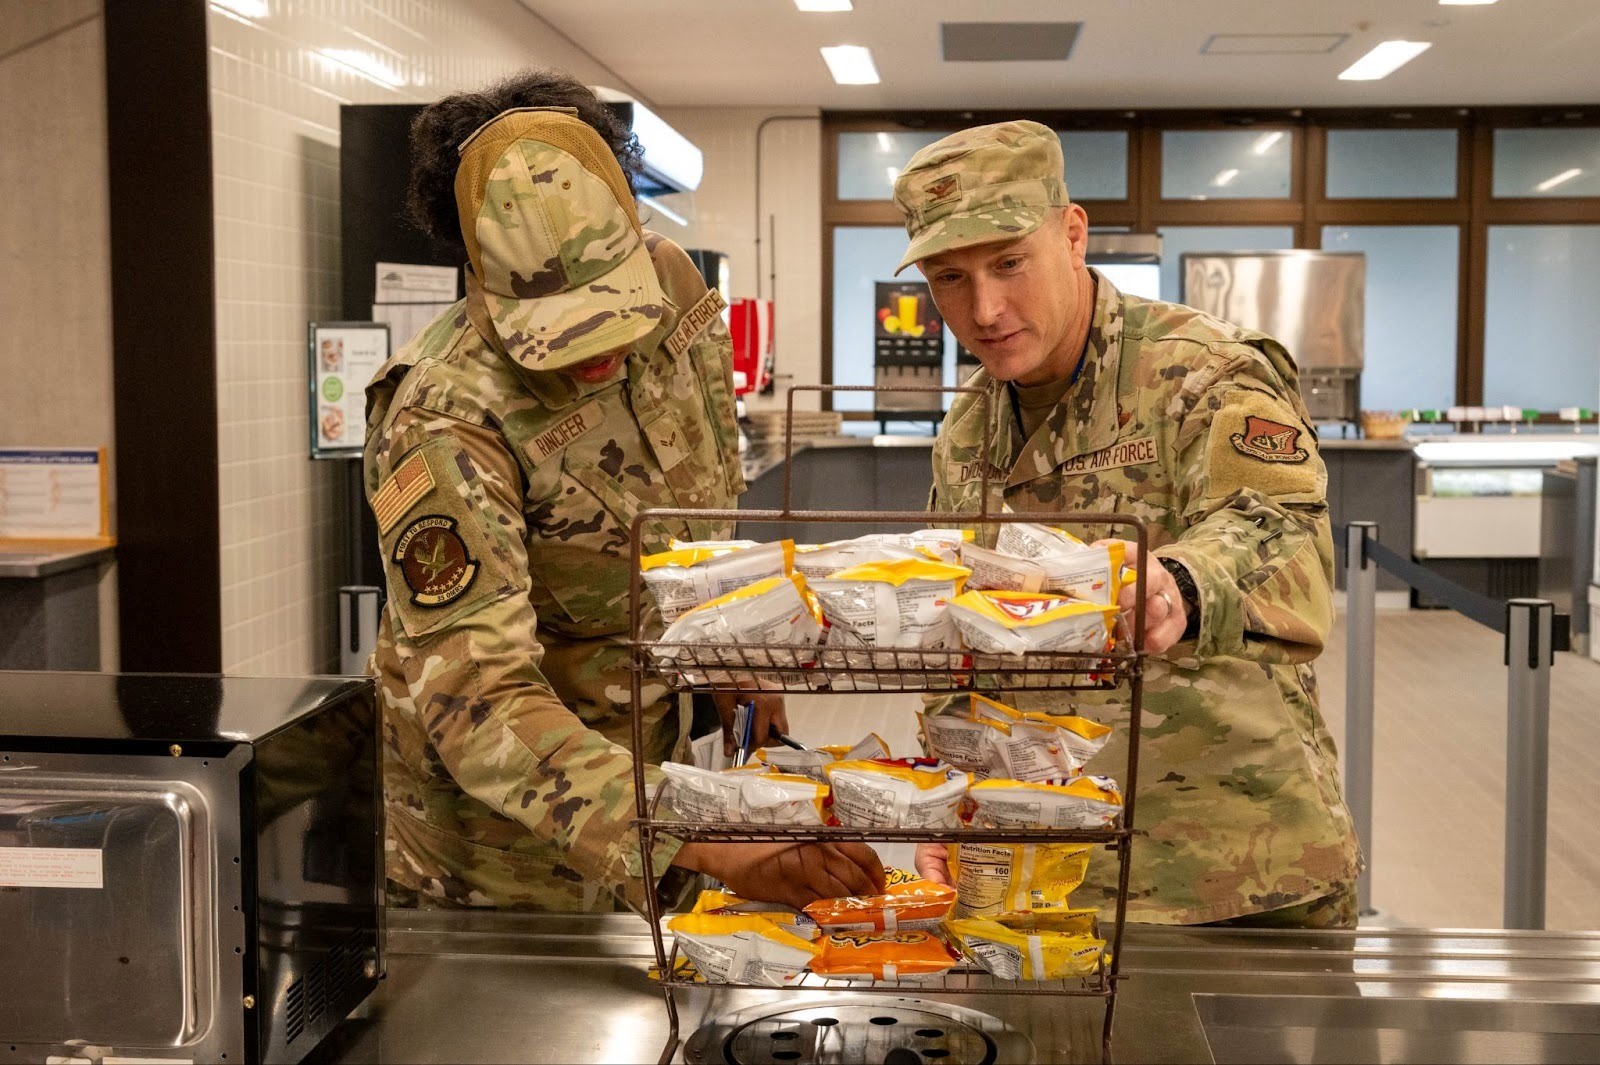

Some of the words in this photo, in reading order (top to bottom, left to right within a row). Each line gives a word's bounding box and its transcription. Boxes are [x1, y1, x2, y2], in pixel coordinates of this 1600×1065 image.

[686, 292, 724, 331] FORCE
[680, 321, 694, 340] AIR
[534, 413, 587, 457] RANCIFER
[1065, 456, 1086, 472] U.S.
[1090, 449, 1111, 469] AIR
[1113, 440, 1154, 465] FORCE
[398, 534, 411, 553] FIRST
[418, 519, 448, 530] RESPOND
[961, 844, 991, 854] Nutrition
[991, 849, 1011, 857] Facts
[994, 867, 1009, 875] 160
[1073, 946, 1098, 957] CRISPY
